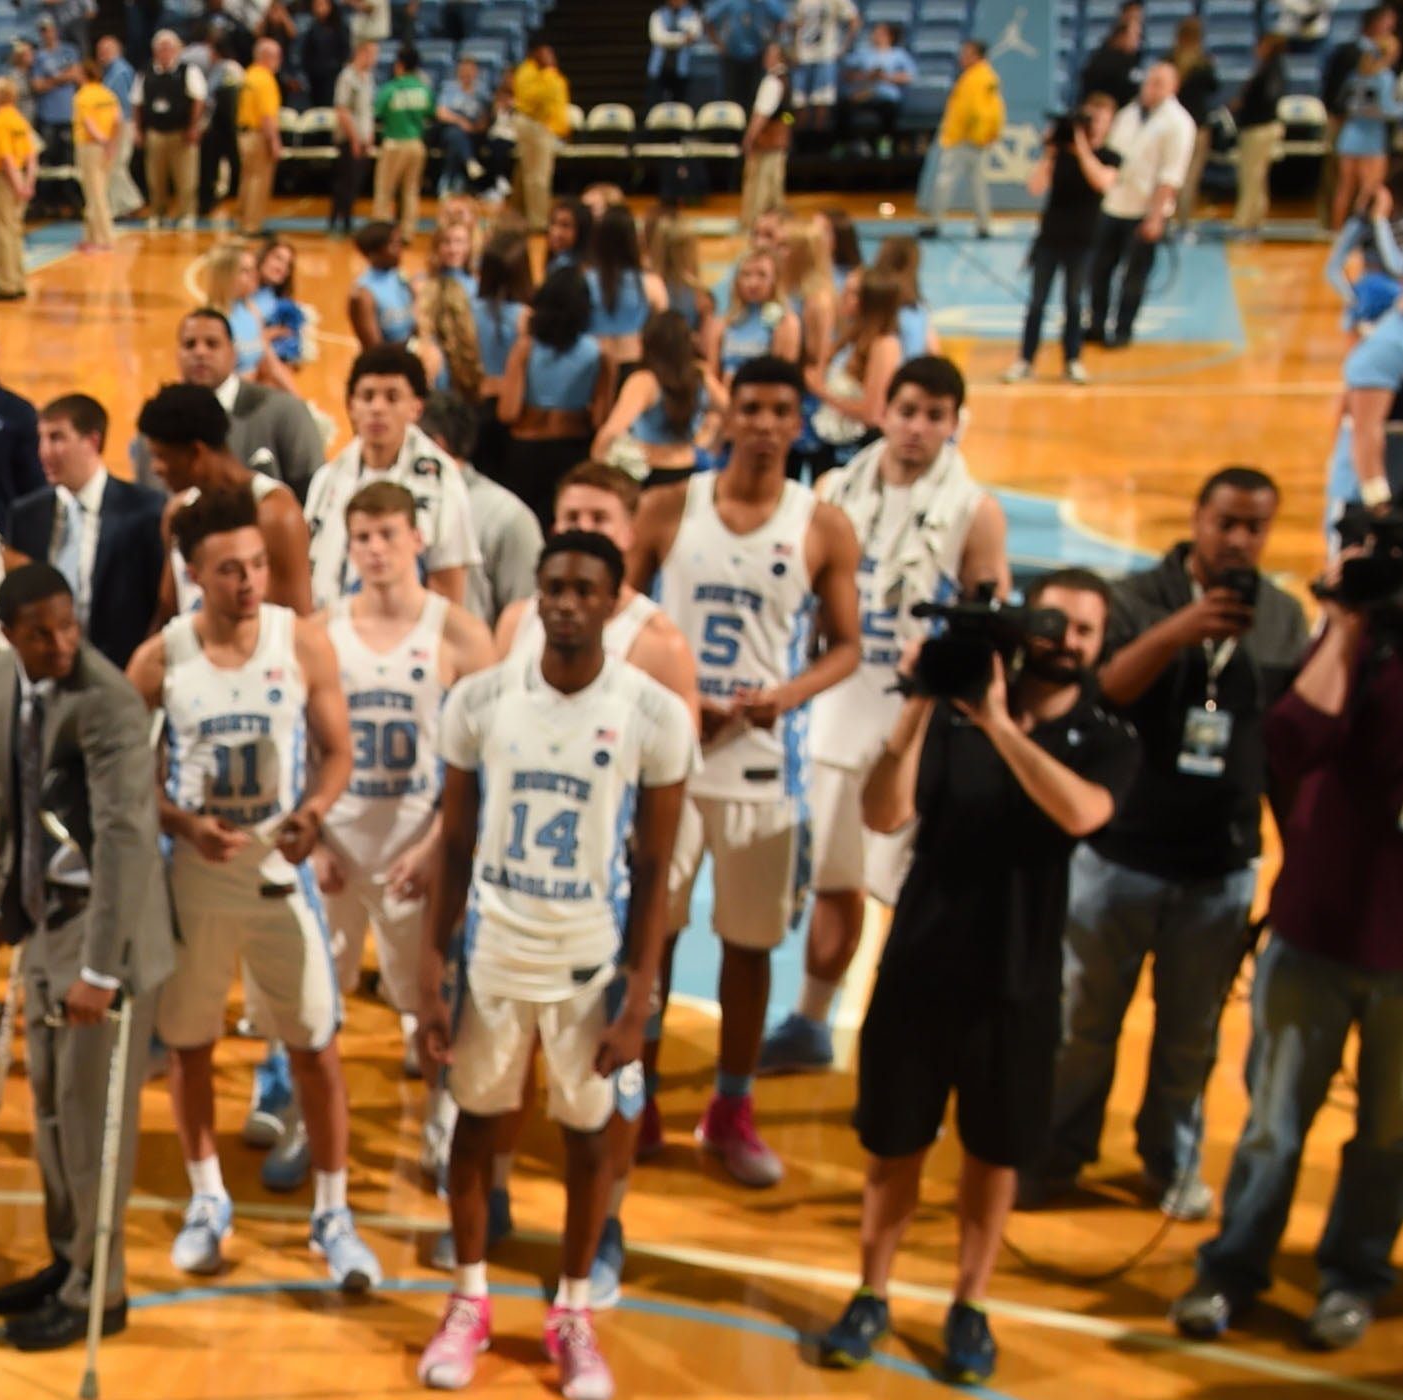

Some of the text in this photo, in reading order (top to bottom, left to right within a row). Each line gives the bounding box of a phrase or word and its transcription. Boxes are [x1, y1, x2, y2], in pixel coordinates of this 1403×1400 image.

[700, 614, 744, 666] 5
[213, 742, 260, 797] 11
[349, 719, 417, 770] 30
[513, 769, 591, 801] NORTH
[506, 803, 579, 868] 14
[481, 863, 593, 900] CAROLINA
